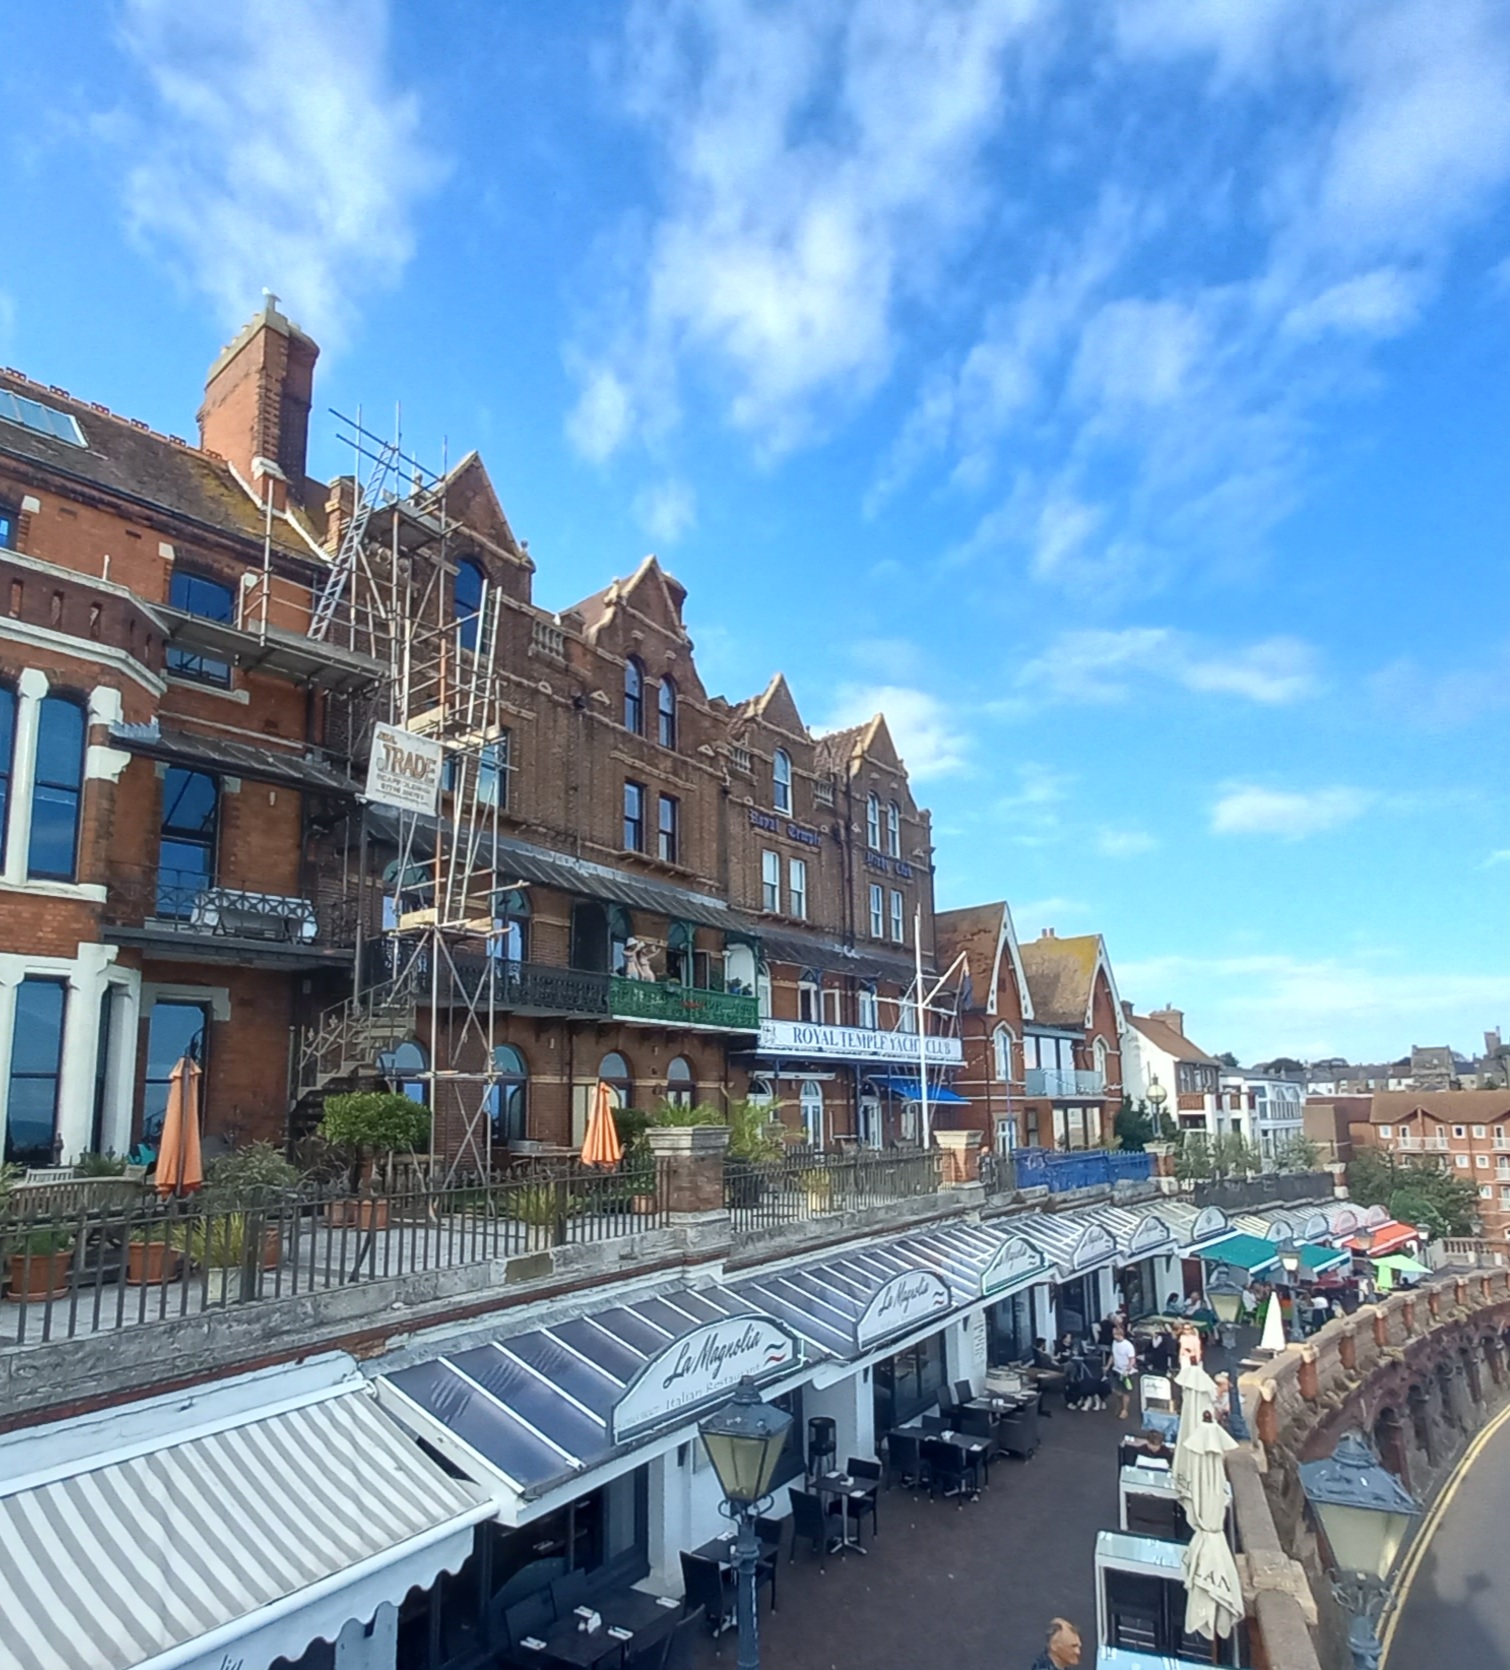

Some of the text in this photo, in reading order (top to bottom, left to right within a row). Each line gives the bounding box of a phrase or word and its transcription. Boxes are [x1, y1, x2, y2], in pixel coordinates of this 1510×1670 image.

[376, 743, 437, 784] TRADE
[793, 1027, 839, 1046] ROYAL
[840, 1031, 887, 1050] TEMPLE
[926, 1039, 951, 1055] CLUB
[662, 1323, 763, 1389] La Magnolia
[666, 1390, 704, 1410] Italian
